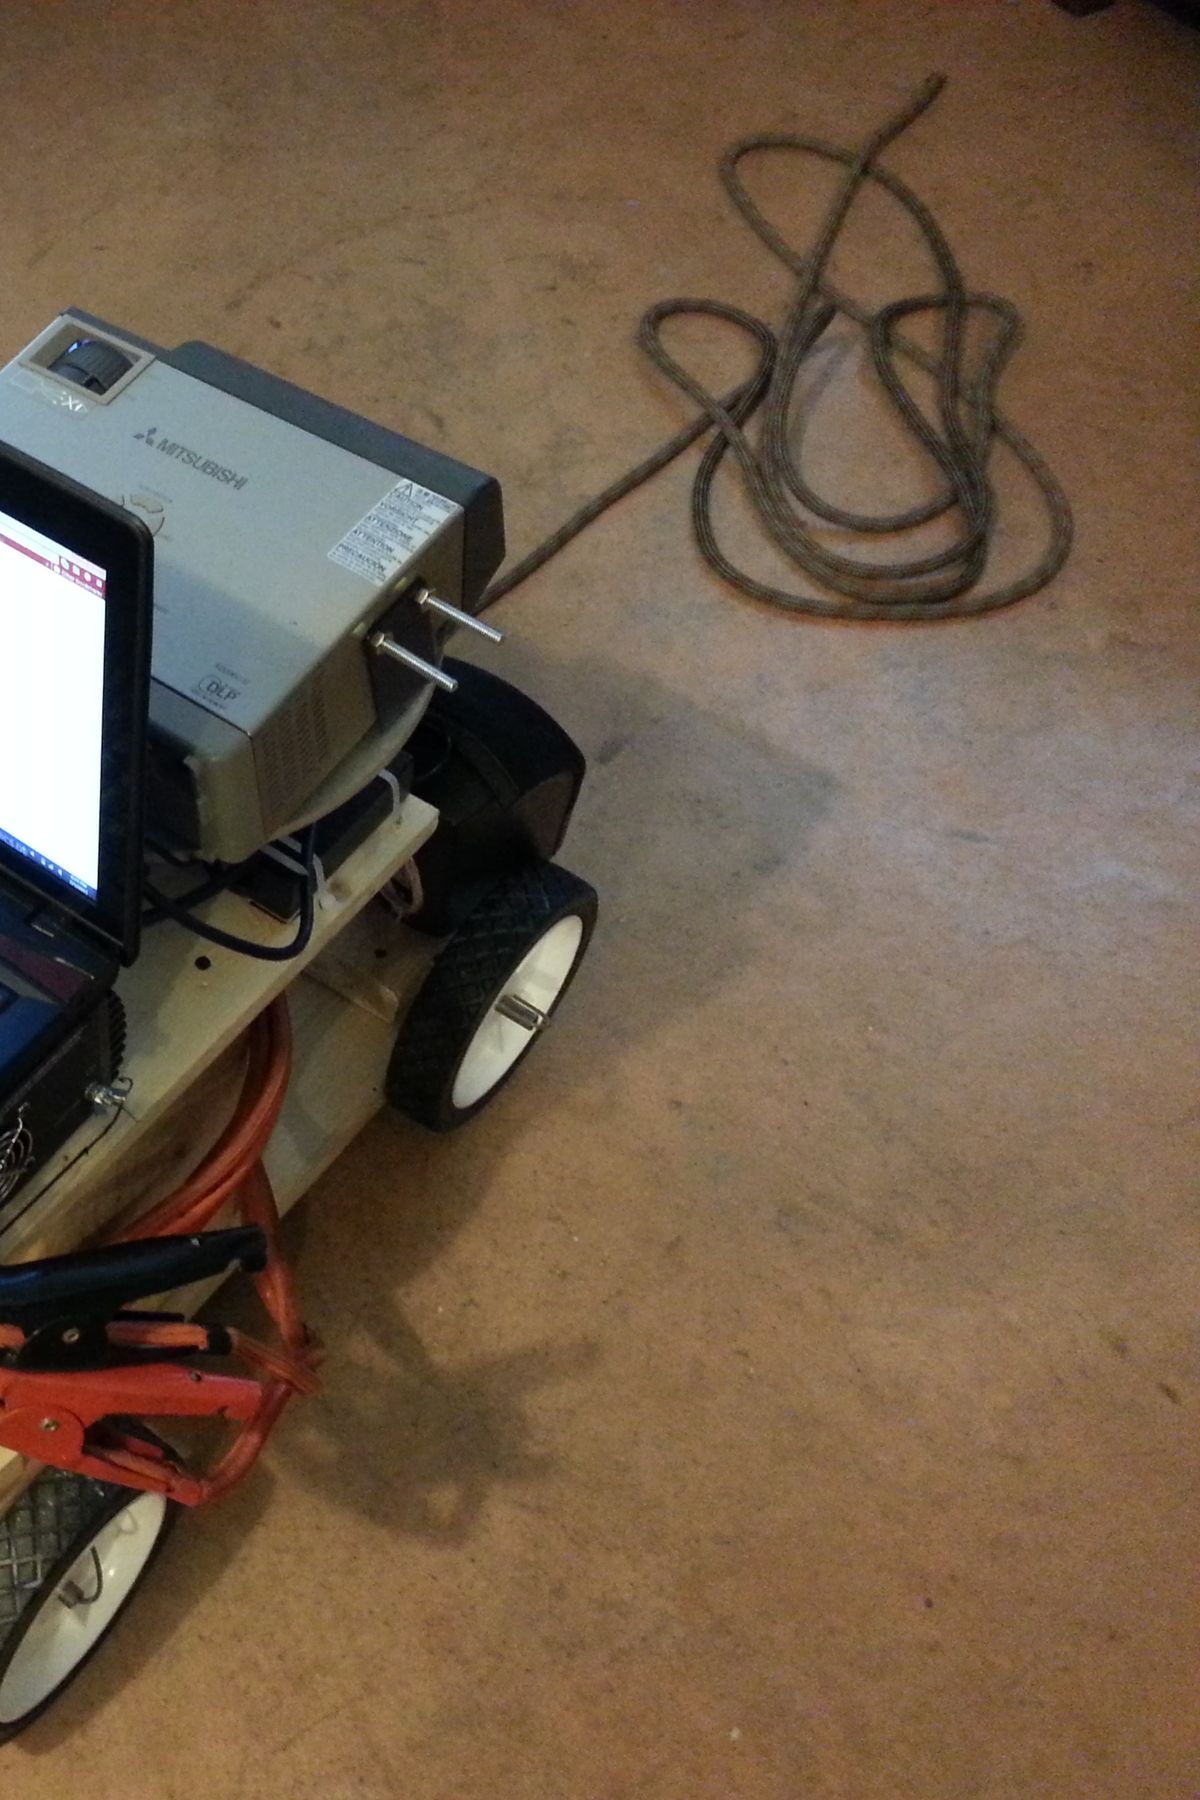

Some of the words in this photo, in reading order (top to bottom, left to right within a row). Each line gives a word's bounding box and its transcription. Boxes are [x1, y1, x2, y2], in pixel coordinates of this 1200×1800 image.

[156, 437, 248, 491] MITSUBISHI
[352, 527, 396, 554] ATTENTION
[206, 680, 237, 700] DLP
